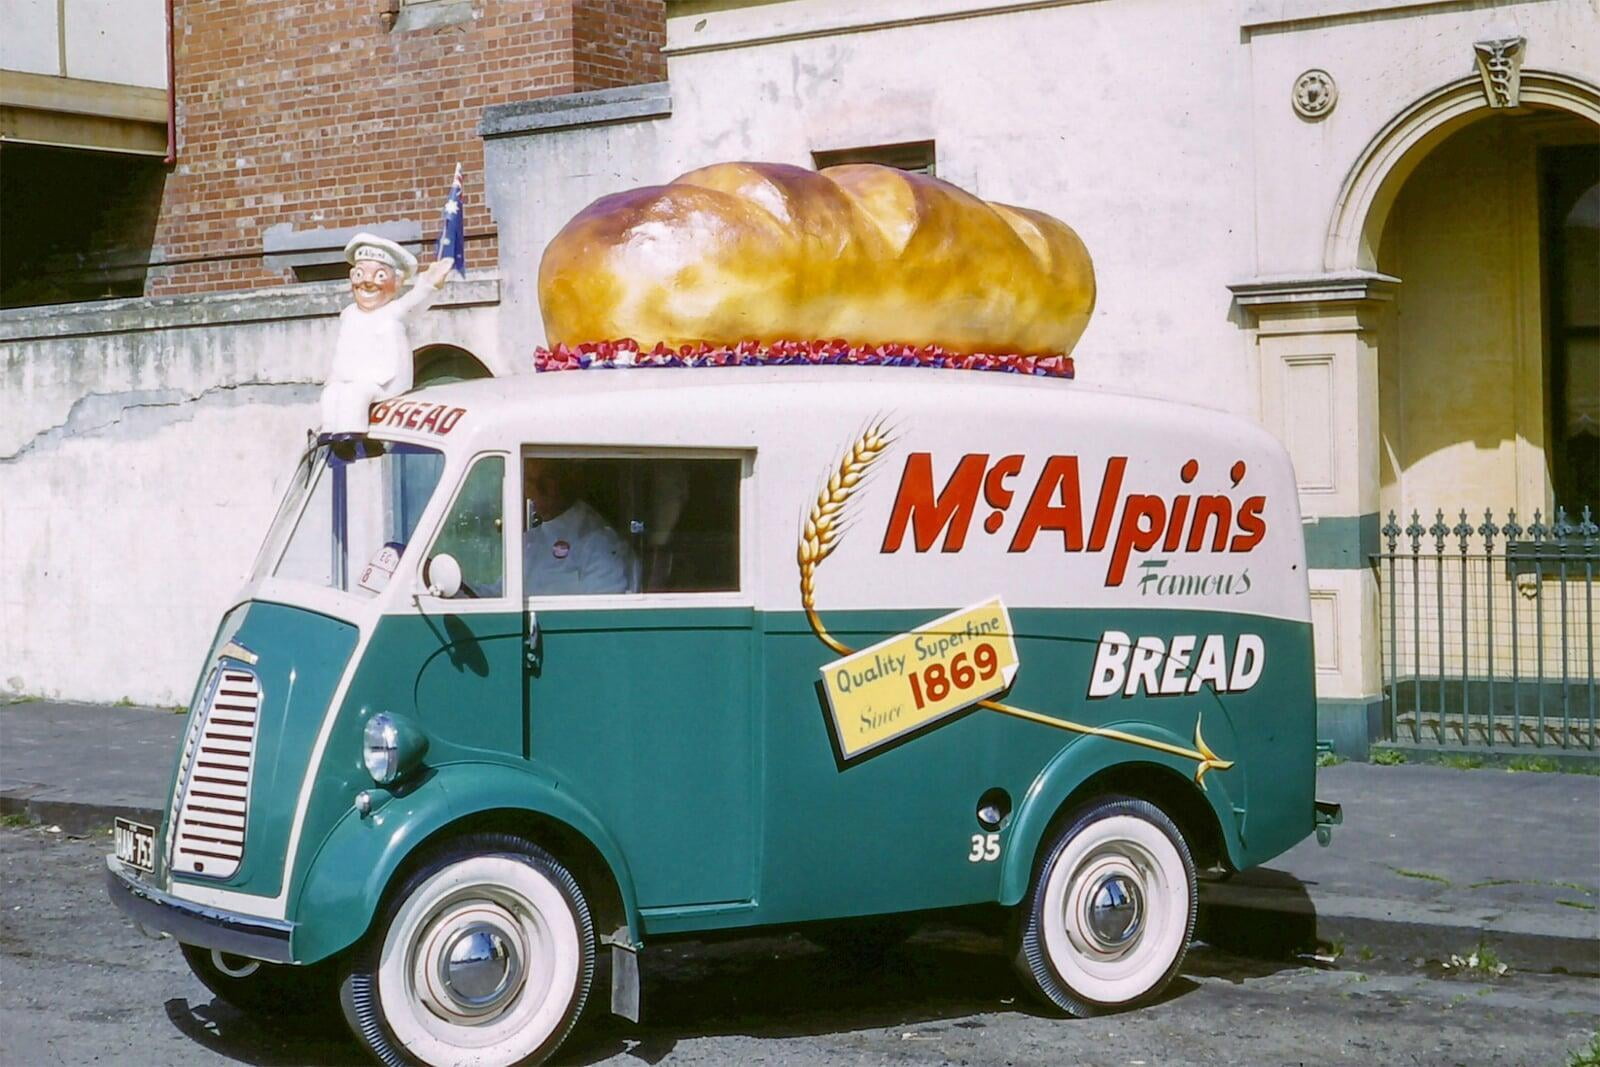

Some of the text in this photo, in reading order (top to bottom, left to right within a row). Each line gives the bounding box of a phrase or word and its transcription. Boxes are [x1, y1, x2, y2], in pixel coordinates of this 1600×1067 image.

[368, 400, 467, 436] BREAD
[880, 453, 1267, 586] McAlpin's
[1138, 556, 1252, 596] Famous
[836, 616, 1001, 694] Quality Superfine
[858, 643, 998, 734] Since 1869
[1088, 630, 1265, 700] BREAD
[968, 832, 1001, 863] 35
